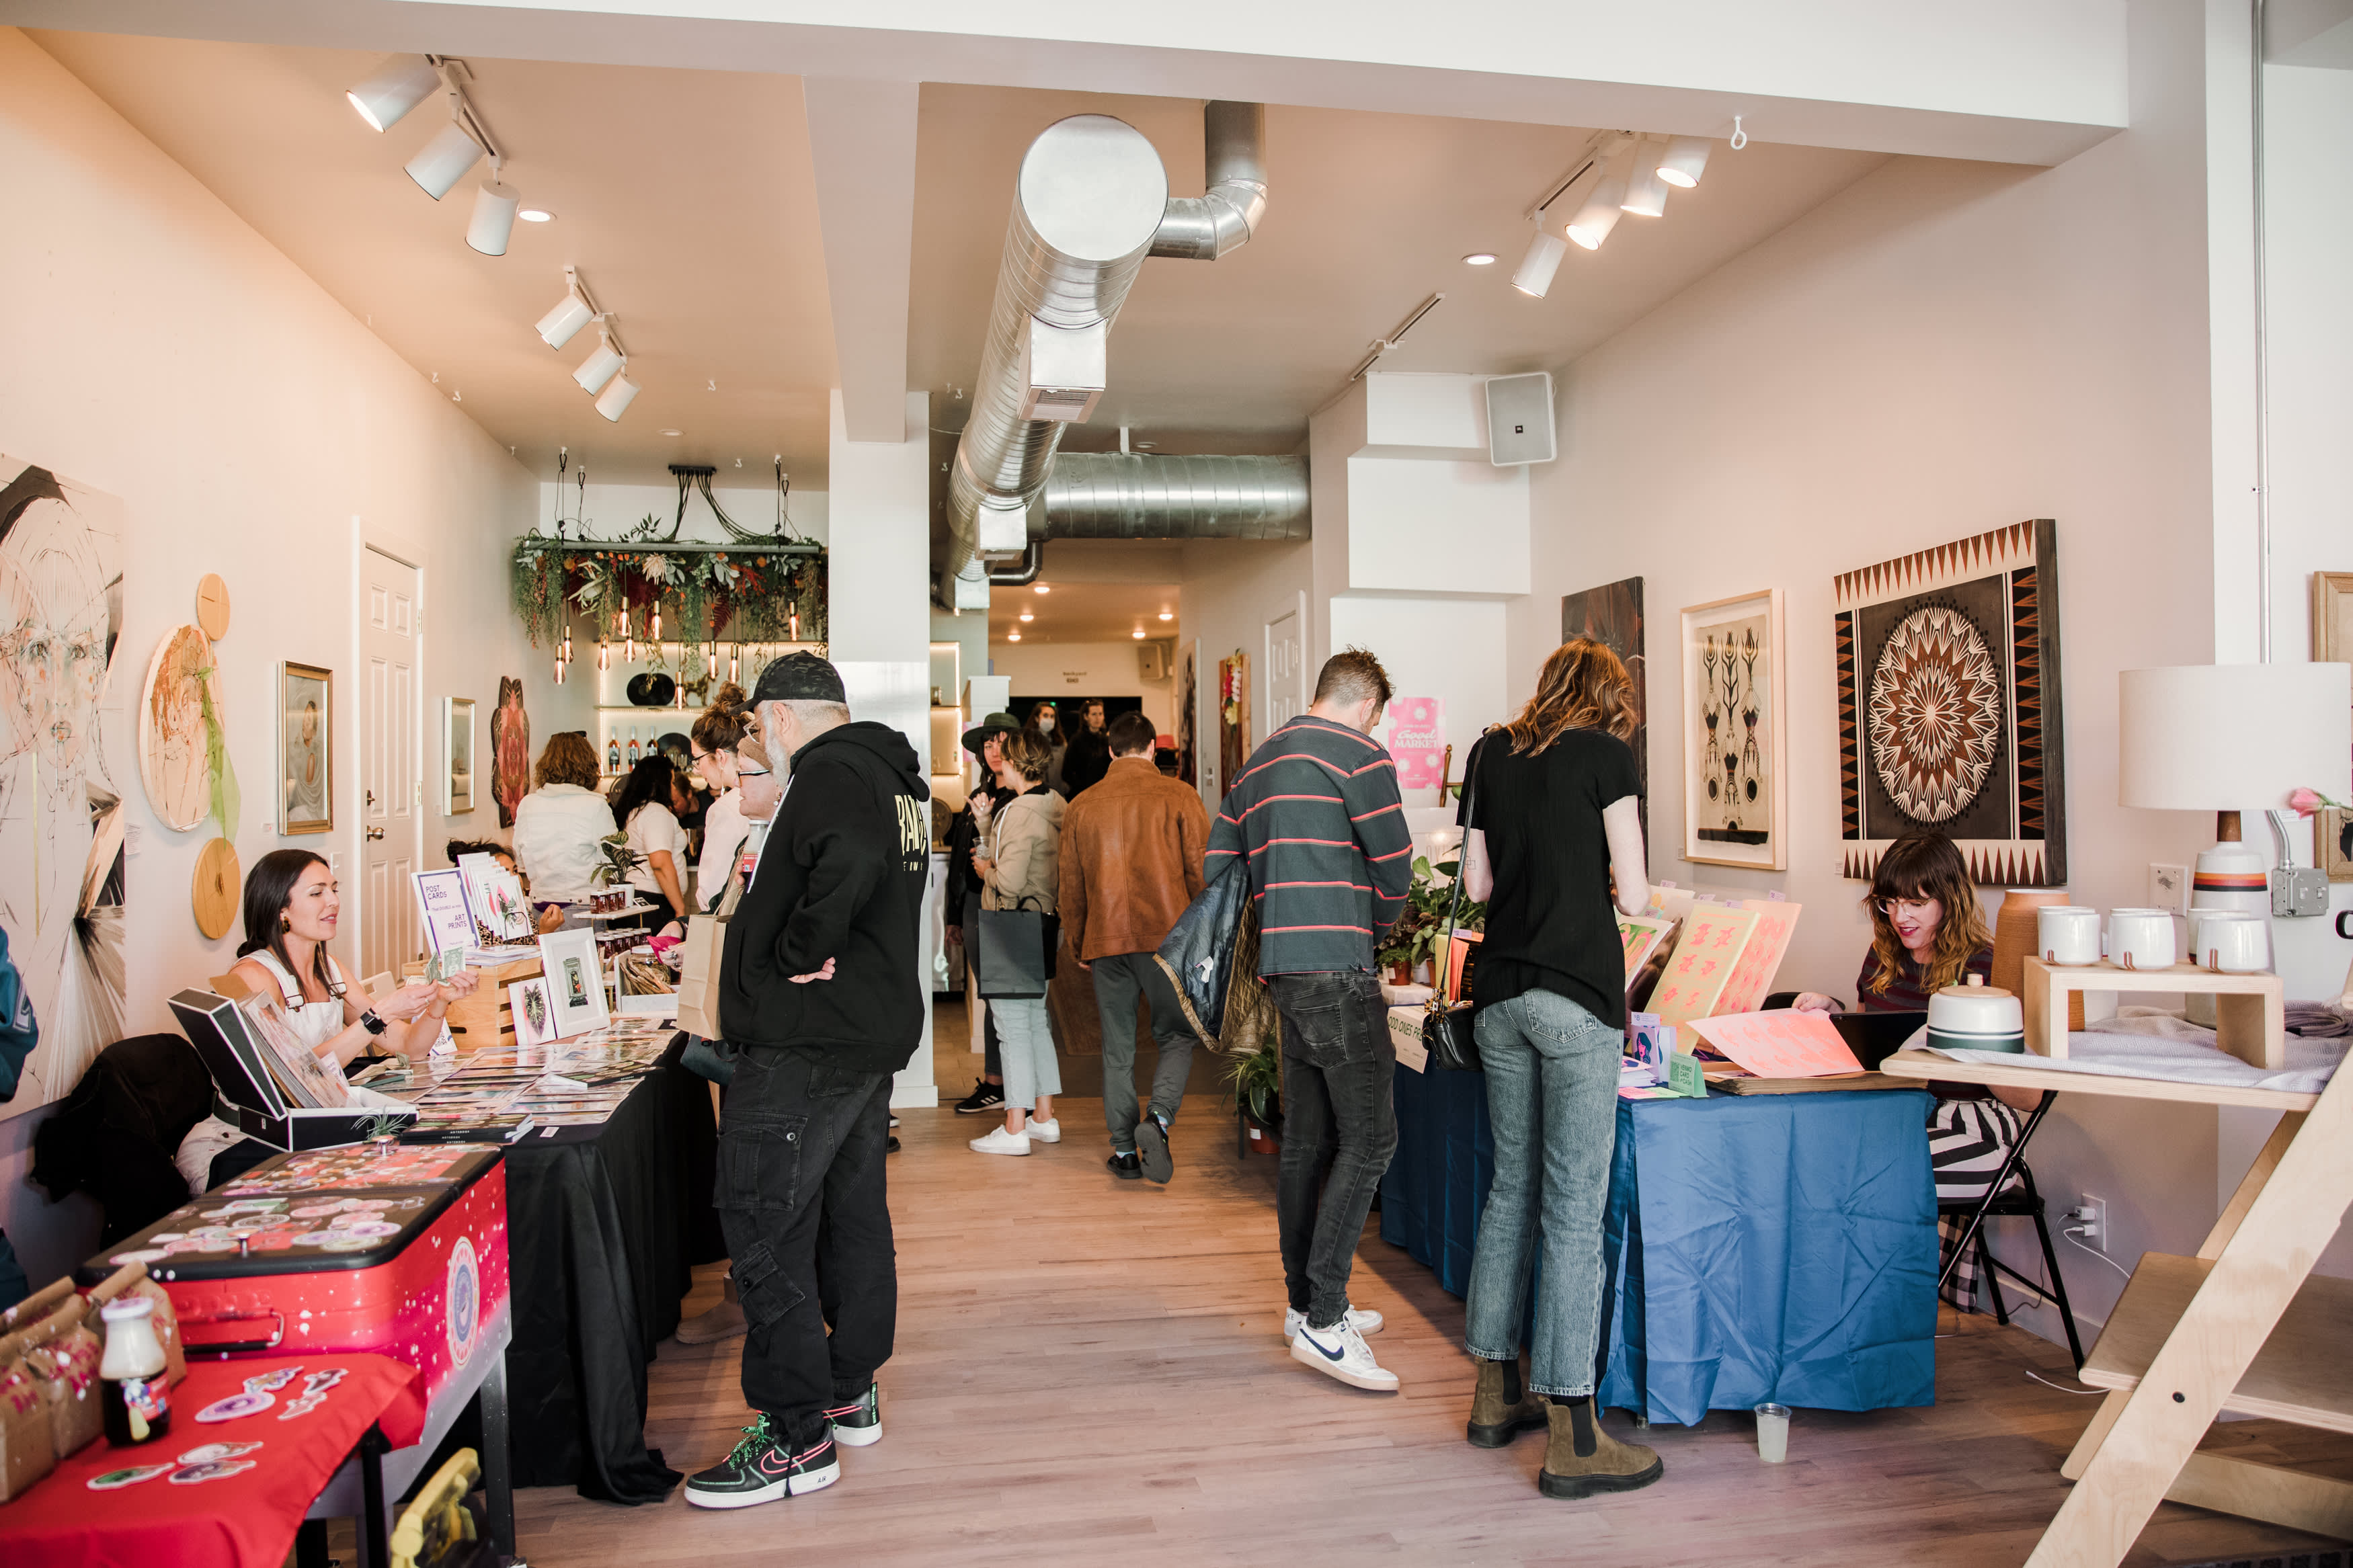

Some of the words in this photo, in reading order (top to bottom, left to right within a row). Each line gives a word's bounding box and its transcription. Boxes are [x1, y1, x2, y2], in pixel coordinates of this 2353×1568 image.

[1397, 729, 1436, 740] Good
[1394, 739, 1437, 748] MARKET
[426, 885, 440, 893] POST
[428, 891, 447, 900] CARDS
[448, 921, 467, 930] PRINTS
[1388, 1016, 1399, 1030] ODD
[1398, 1021, 1413, 1036] ONES
[1681, 1064, 1693, 1073] VENMO
[1680, 1071, 1689, 1079] CARD
[1683, 1078, 1692, 1086] CASH
[817, 1475, 828, 1484] AIR
